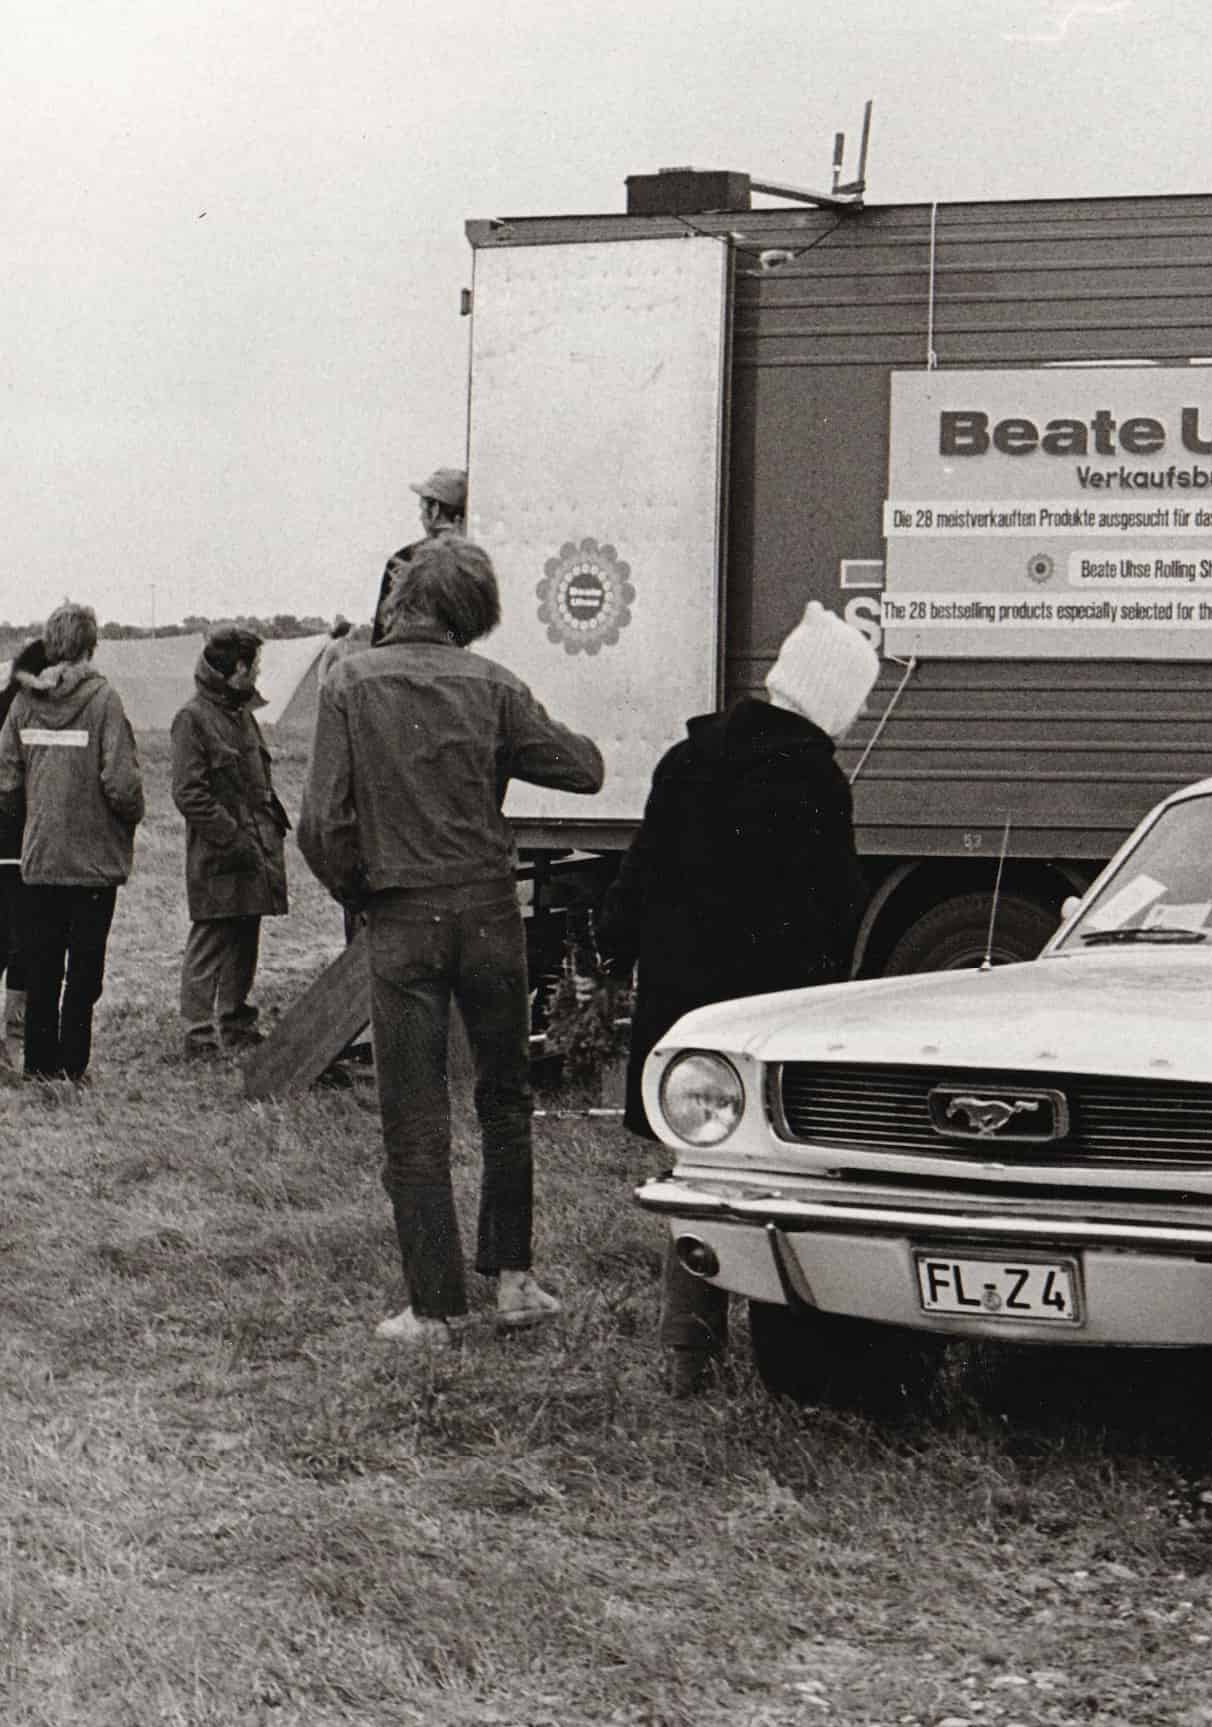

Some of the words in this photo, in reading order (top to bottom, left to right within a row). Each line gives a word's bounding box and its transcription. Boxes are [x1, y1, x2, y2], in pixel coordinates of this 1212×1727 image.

[938, 409, 1167, 457] Beate
[893, 509, 913, 529] Die
[915, 509, 934, 529] 28
[936, 509, 1037, 529] meistverkauften
[1039, 508, 1096, 529] Produkte
[1098, 508, 1170, 531] ausgesucht
[1173, 508, 1192, 528] für
[1080, 559, 1118, 579] Beate
[1119, 559, 1152, 579] Uhse
[1154, 559, 1197, 582] Rolling
[883, 600, 906, 620] The
[908, 601, 927, 620] 28
[930, 601, 996, 623] bestselling
[998, 601, 1054, 623] products
[1056, 601, 1118, 623] especially
[1119, 601, 1174, 621] selected
[1176, 601, 1195, 621] for
